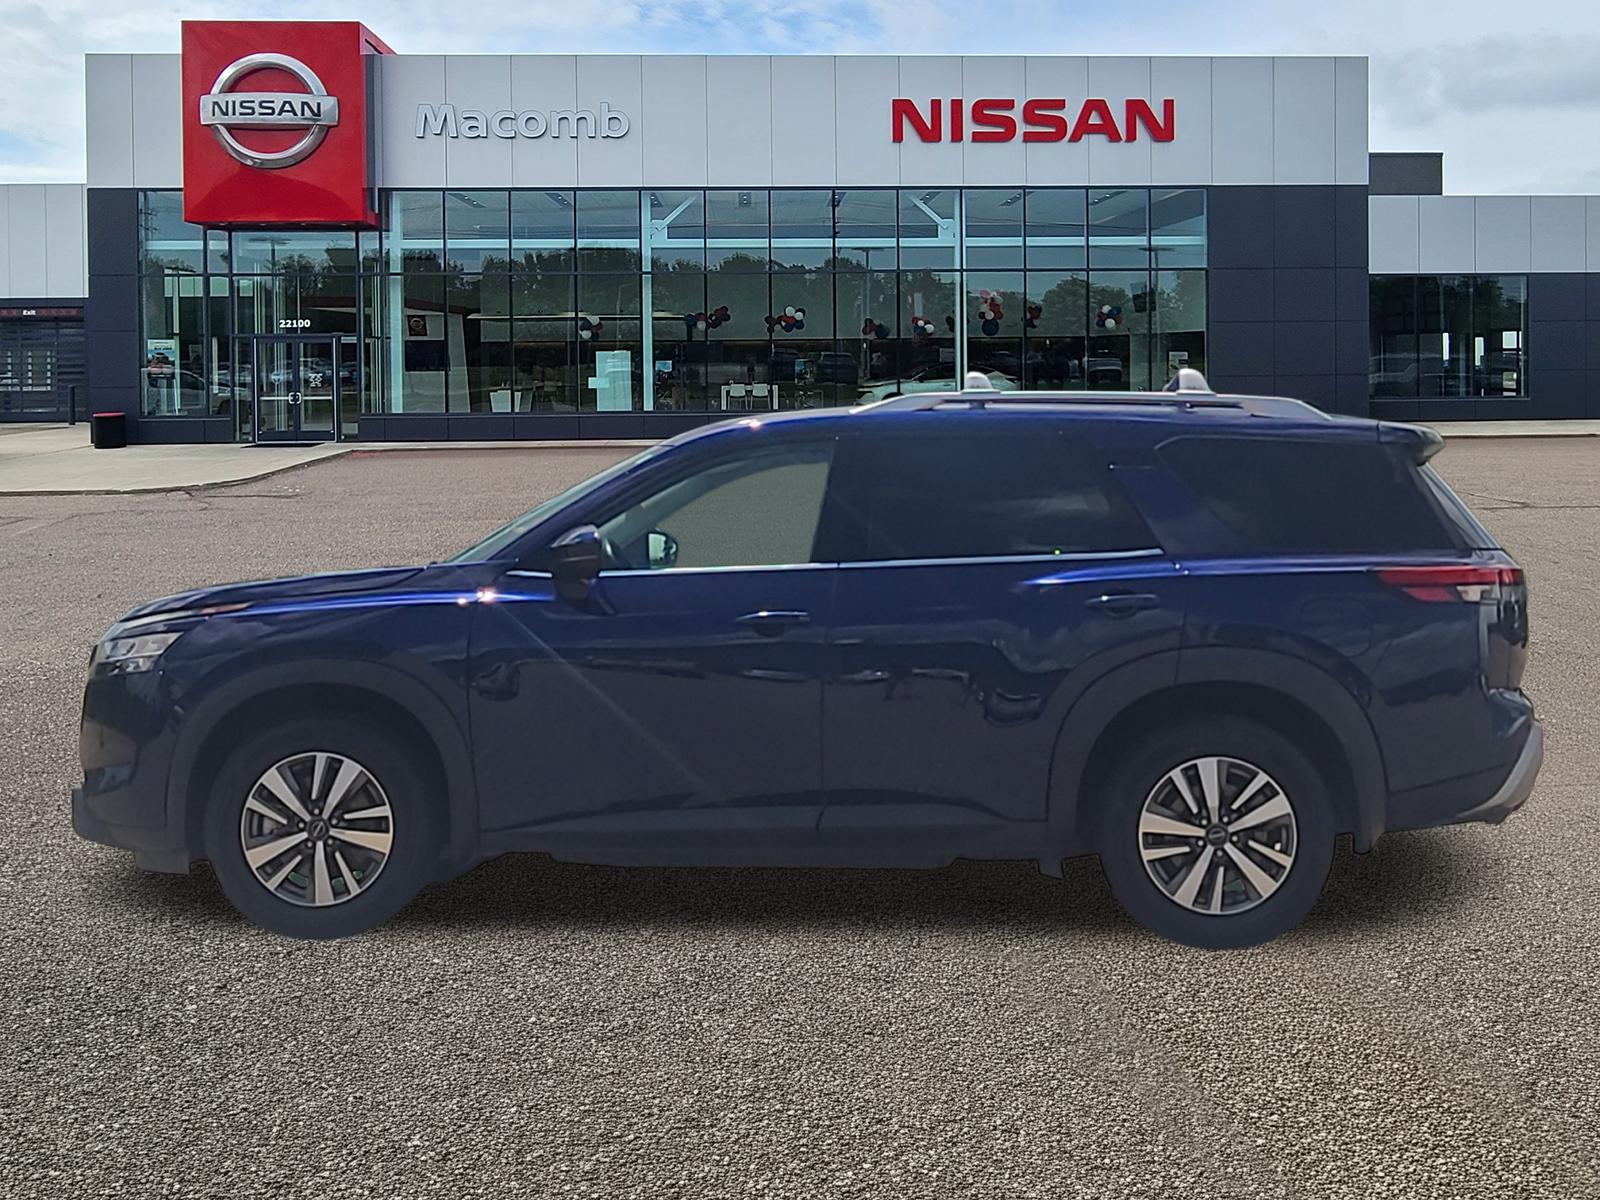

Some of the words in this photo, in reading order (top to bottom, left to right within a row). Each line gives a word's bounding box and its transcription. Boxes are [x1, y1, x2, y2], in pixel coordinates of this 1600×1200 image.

[211, 100, 322, 117] NISSAN
[415, 102, 630, 138] Macomb
[892, 98, 1176, 143] NISSAN
[279, 319, 311, 328] 22100
